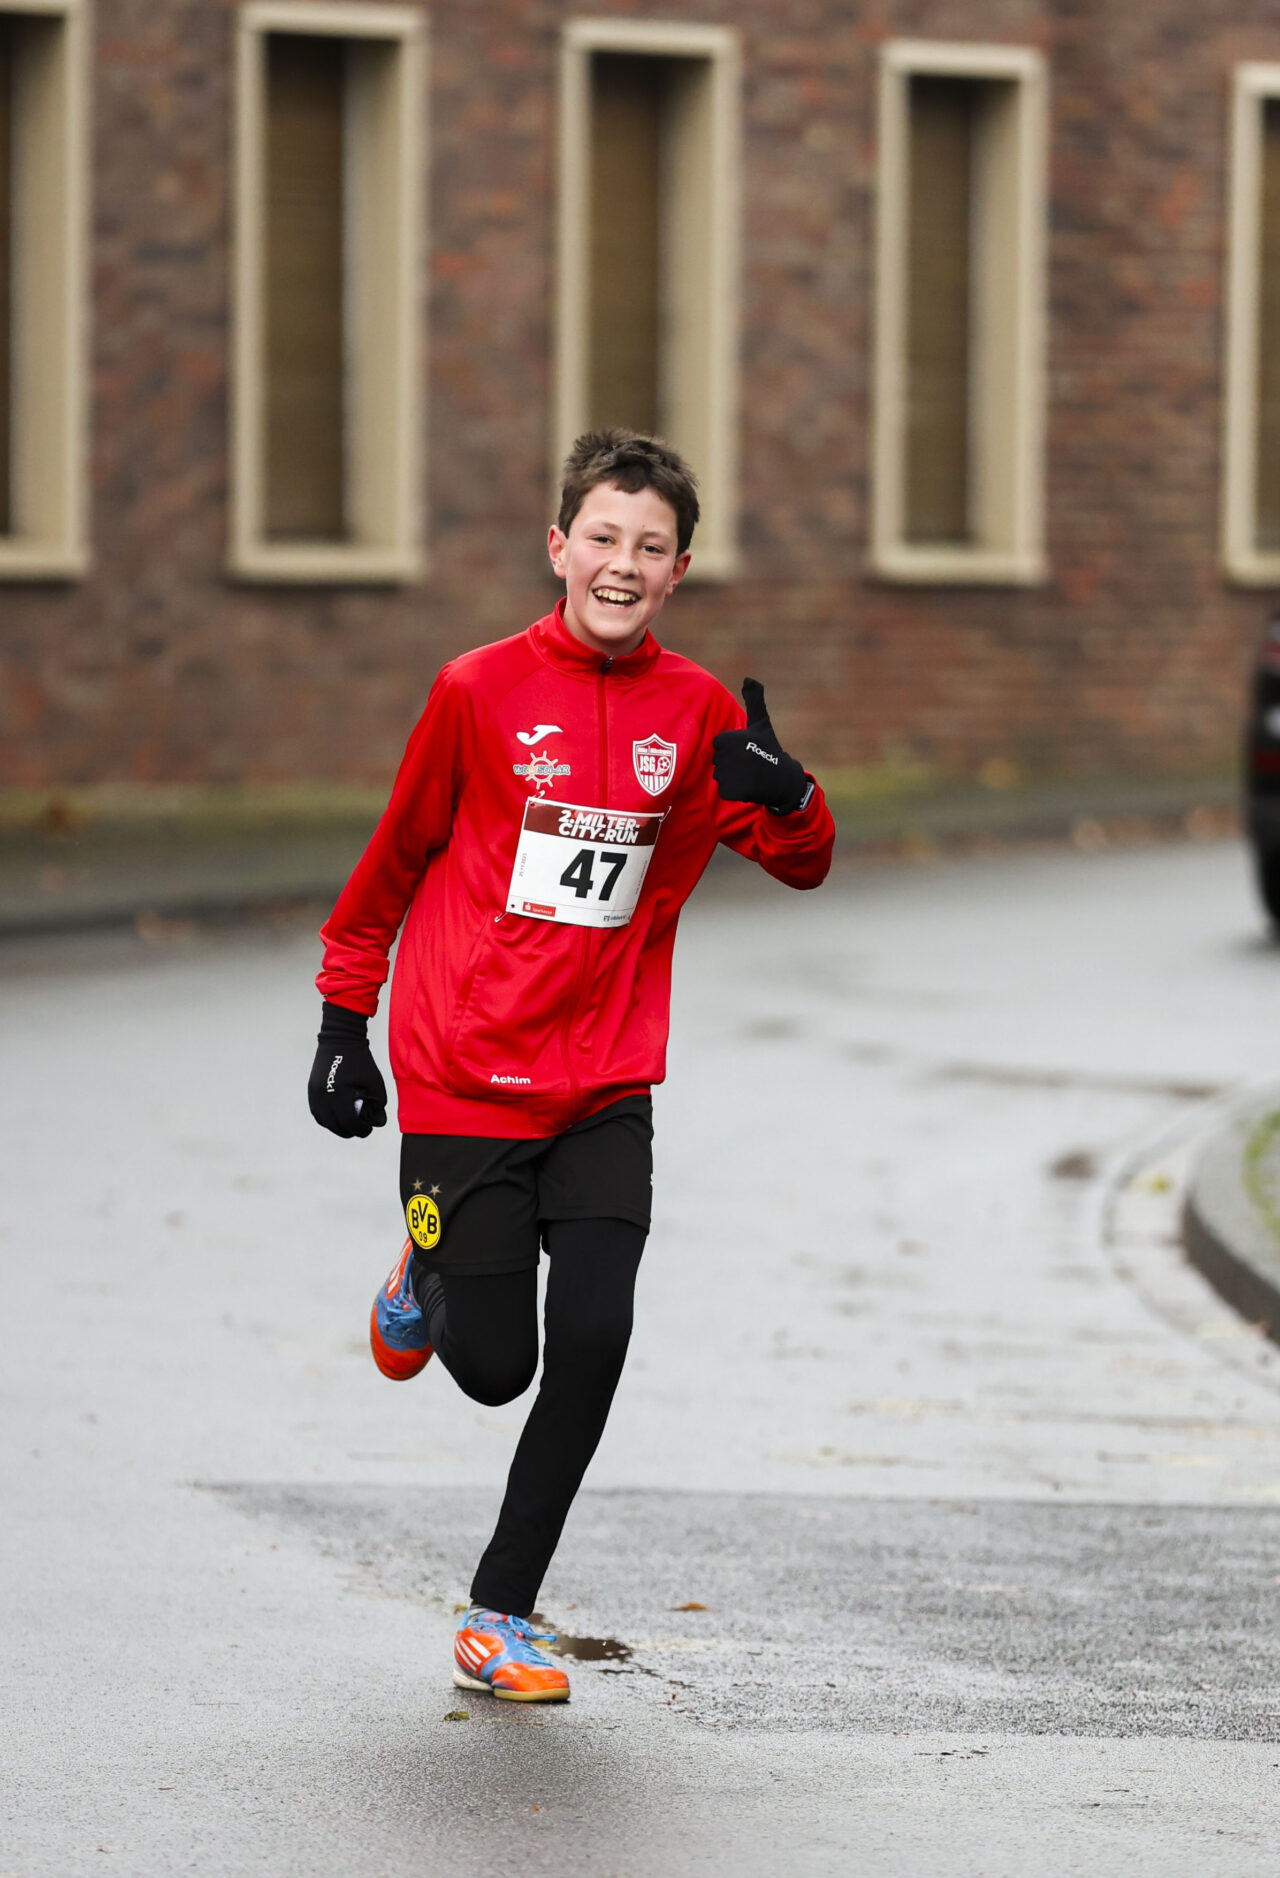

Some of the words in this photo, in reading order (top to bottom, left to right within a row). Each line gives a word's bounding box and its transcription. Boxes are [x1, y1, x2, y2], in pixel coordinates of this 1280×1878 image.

[640, 755, 656, 773] JSG
[746, 742, 778, 765] Roeckl
[558, 822, 639, 844] CITY-RUN
[559, 848, 628, 901] 47
[327, 1055, 343, 1093] Roeckl
[490, 1074, 532, 1086] Achim
[411, 1200, 438, 1235] BVB
[418, 1231, 428, 1243] 09
